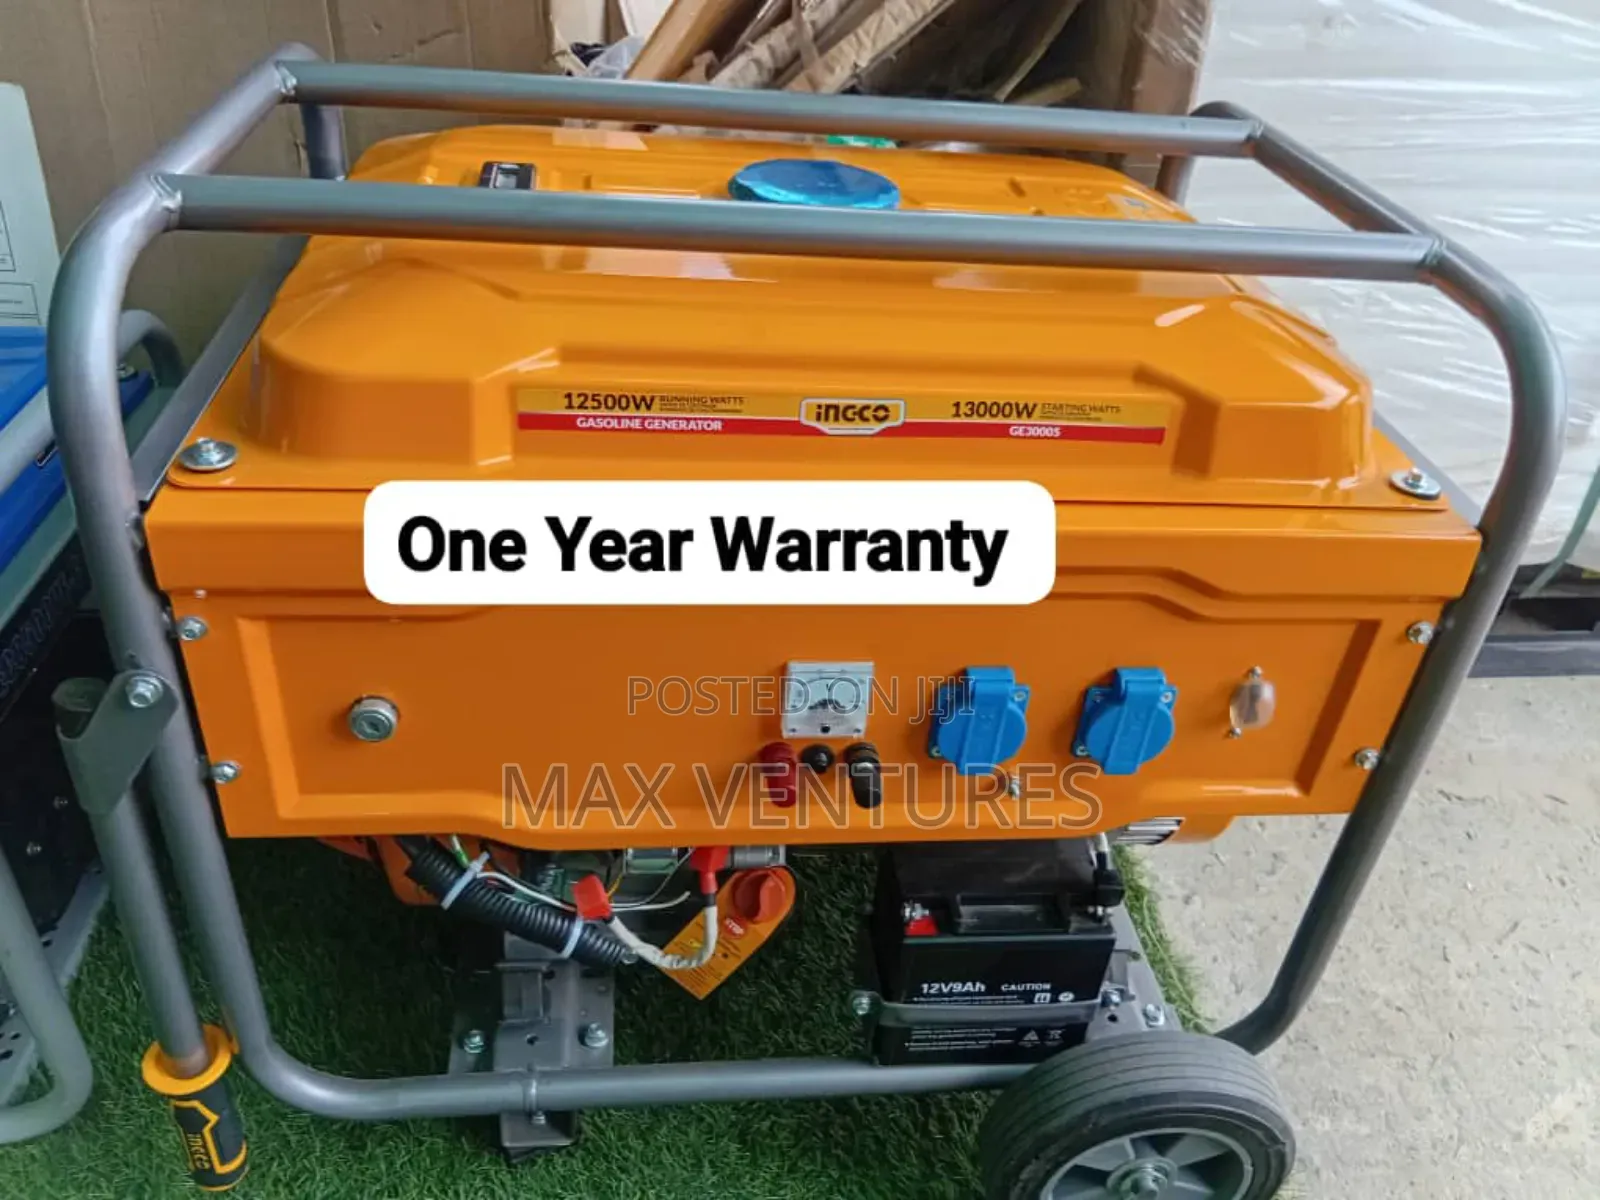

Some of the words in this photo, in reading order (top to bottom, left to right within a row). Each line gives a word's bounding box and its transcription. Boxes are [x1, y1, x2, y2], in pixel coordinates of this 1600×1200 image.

[564, 392, 656, 411] 12500W
[951, 401, 1038, 419] 13000W
[576, 416, 643, 430] GASOLINE
[644, 418, 723, 431] GENERATOR
[921, 982, 986, 994] 12V9Ah
[1000, 983, 1052, 992] CAUTION
